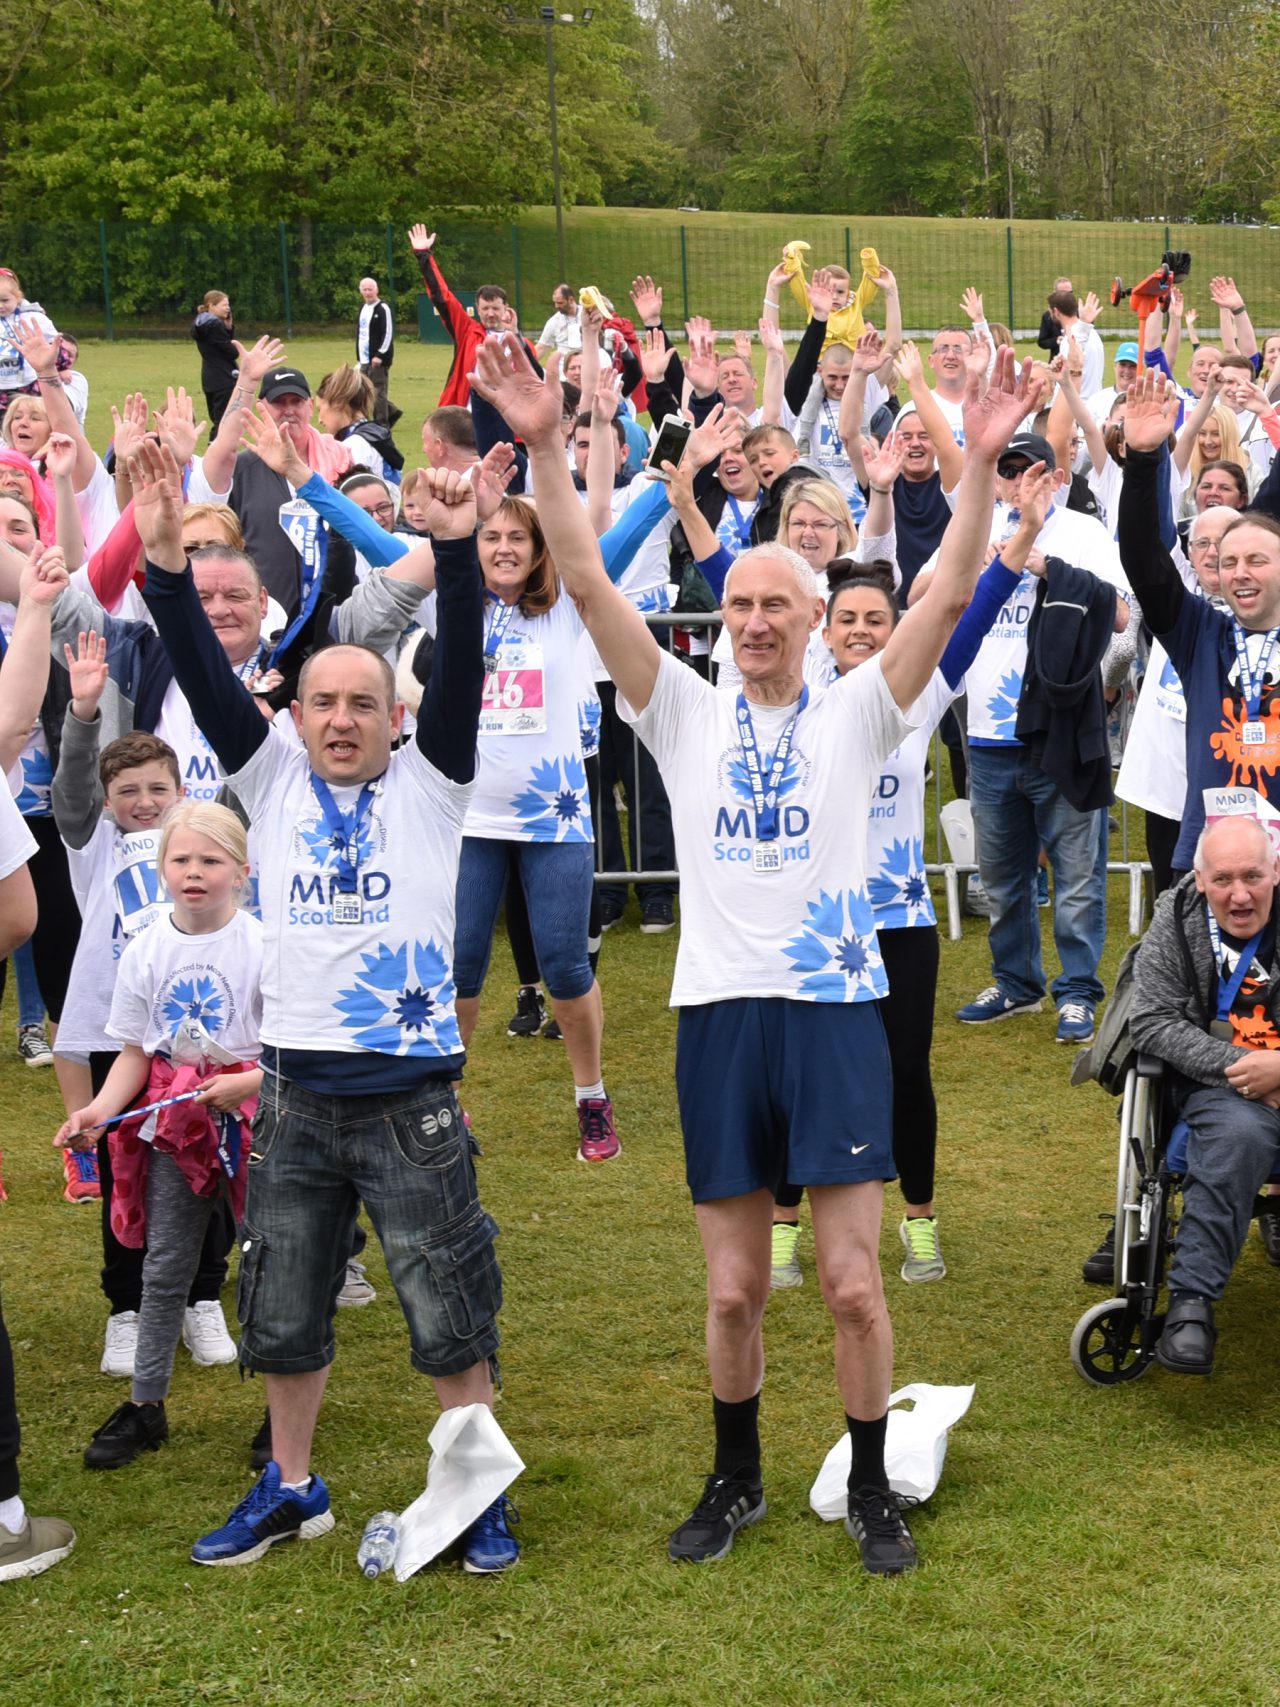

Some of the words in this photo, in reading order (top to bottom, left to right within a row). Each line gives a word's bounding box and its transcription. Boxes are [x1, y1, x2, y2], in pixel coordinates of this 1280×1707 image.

[999, 605, 1029, 624] ND
[988, 626, 1027, 638] otland
[777, 737, 789, 758] 2017
[745, 751, 759, 772] 2017
[751, 774, 763, 792] FUN
[1216, 793, 1247, 806] MND
[714, 806, 810, 839] MD
[122, 838, 154, 855] MND
[714, 840, 810, 862] Scond
[289, 904, 390, 925] Scotnd
